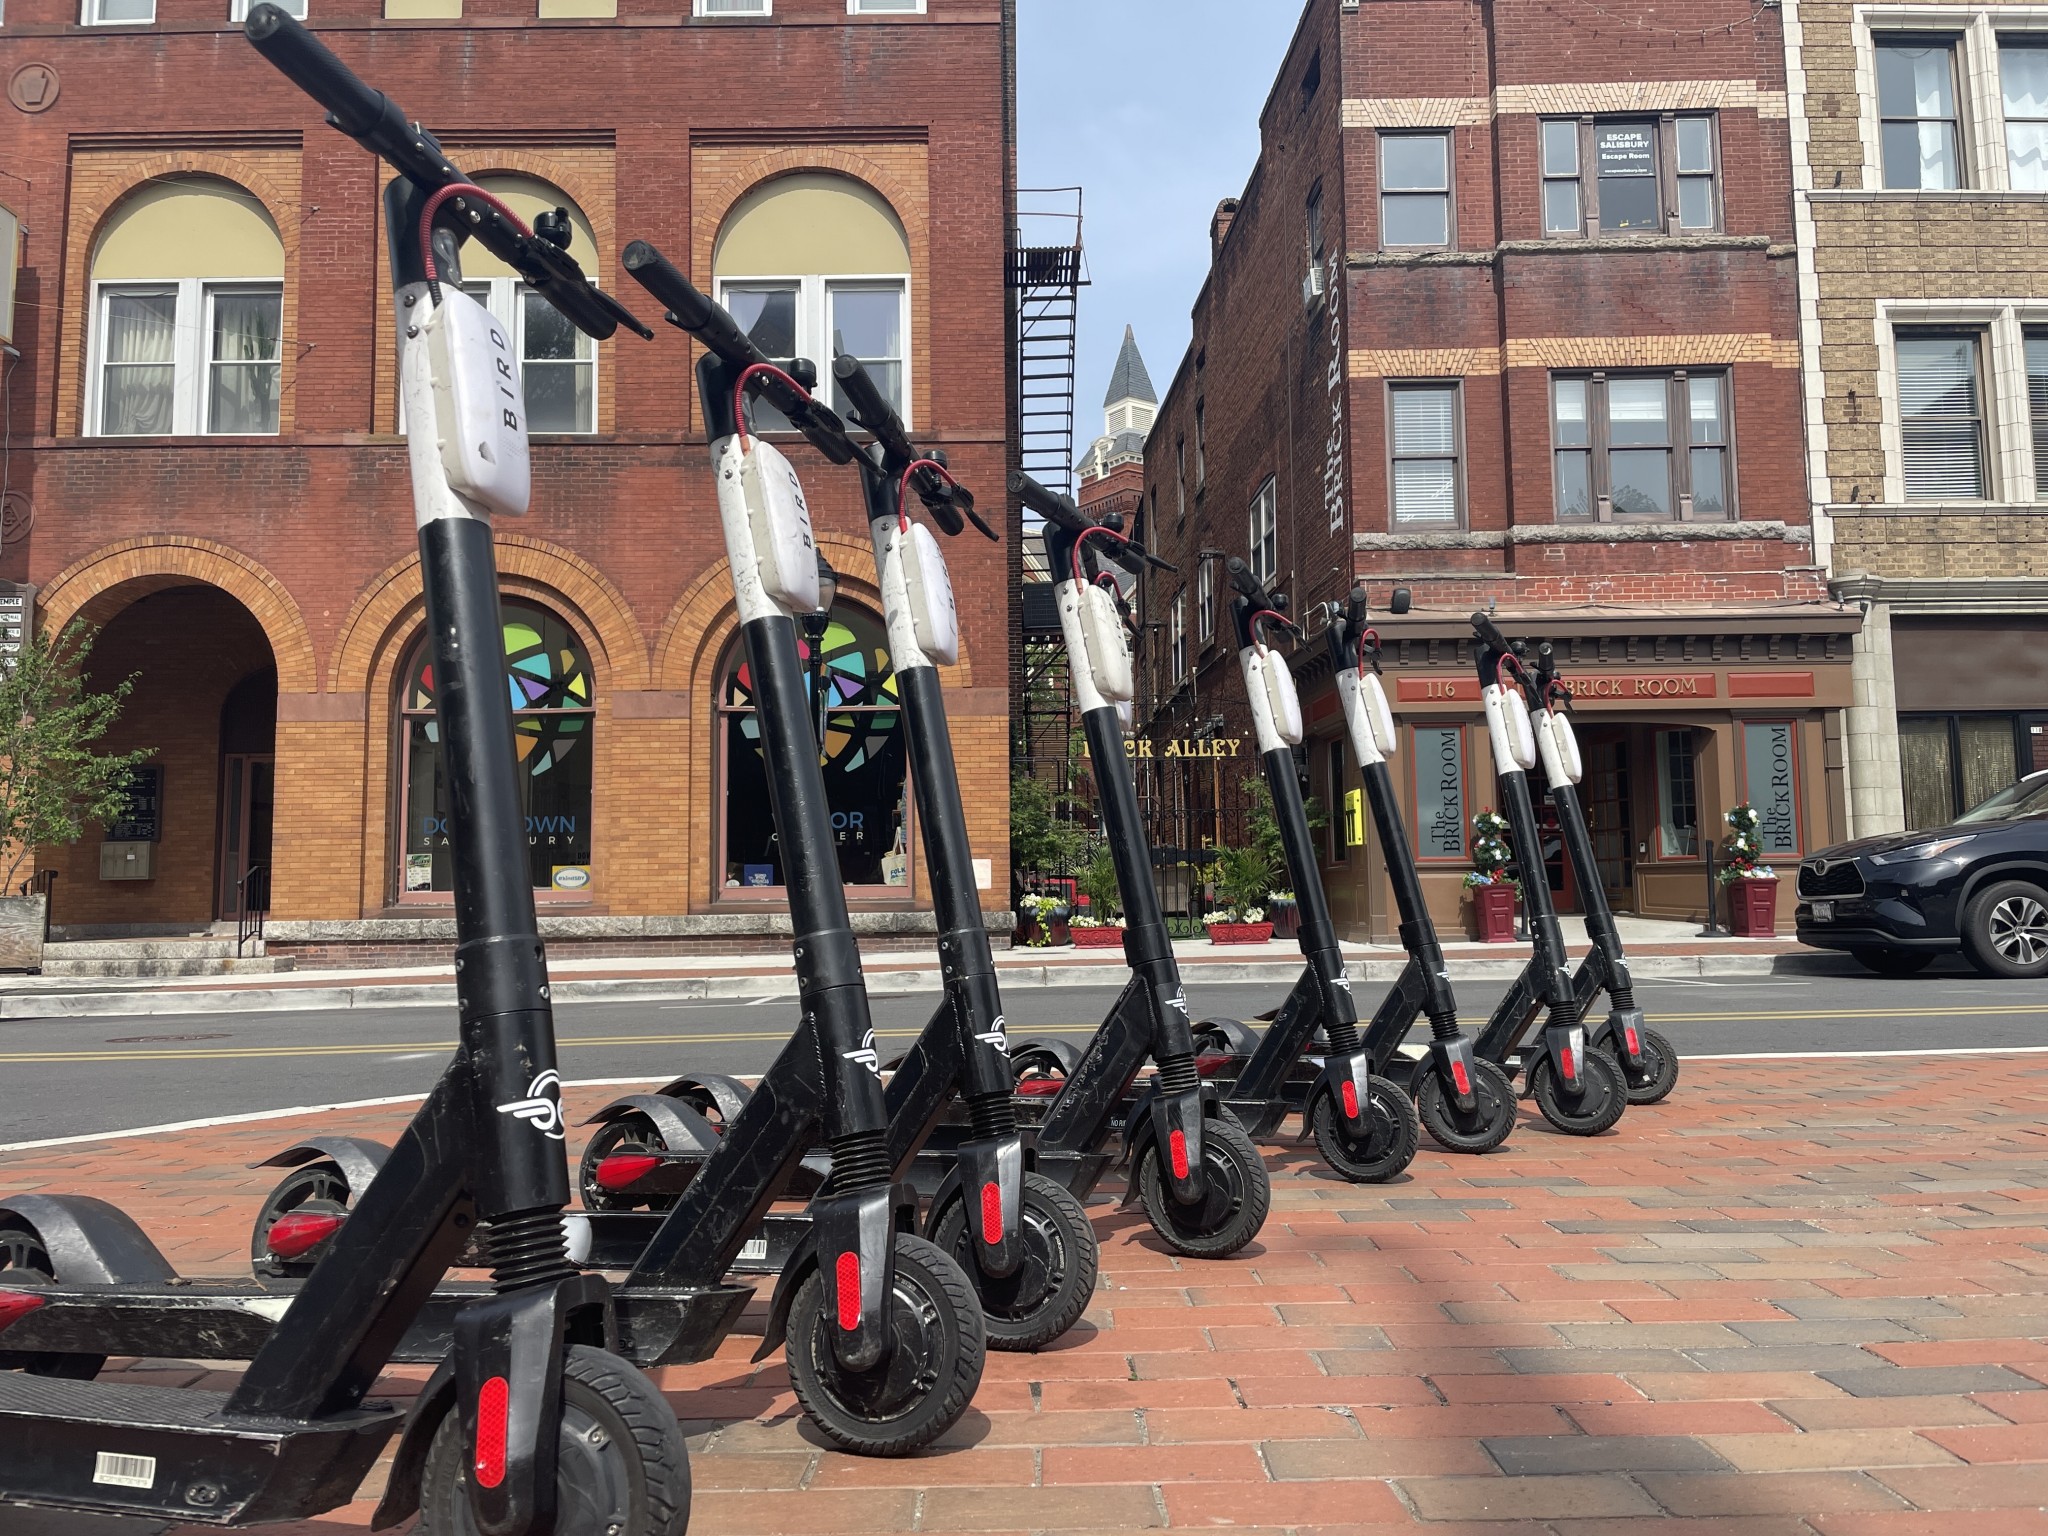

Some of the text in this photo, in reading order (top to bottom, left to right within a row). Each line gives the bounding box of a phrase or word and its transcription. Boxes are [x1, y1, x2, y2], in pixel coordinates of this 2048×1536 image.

[1600, 141, 1649, 149] SALISBURY
[1606, 133, 1642, 141] ESCAPE
[1601, 153, 1627, 161] Escape
[490, 328, 518, 432] BIRD
[1328, 246, 1344, 539] BRICK ROOM
[1324, 436, 1334, 511] The
[788, 471, 812, 550] BIRD
[1427, 681, 1455, 698] 116
[1564, 677, 1698, 697] BRICK ROOM
[1164, 739, 1240, 758] ALLEY
[1440, 731, 1461, 853] BRICK ROOM
[1771, 727, 1792, 849] BRICK ROOM
[1431, 810, 1446, 843] The
[1762, 807, 1778, 840] The
